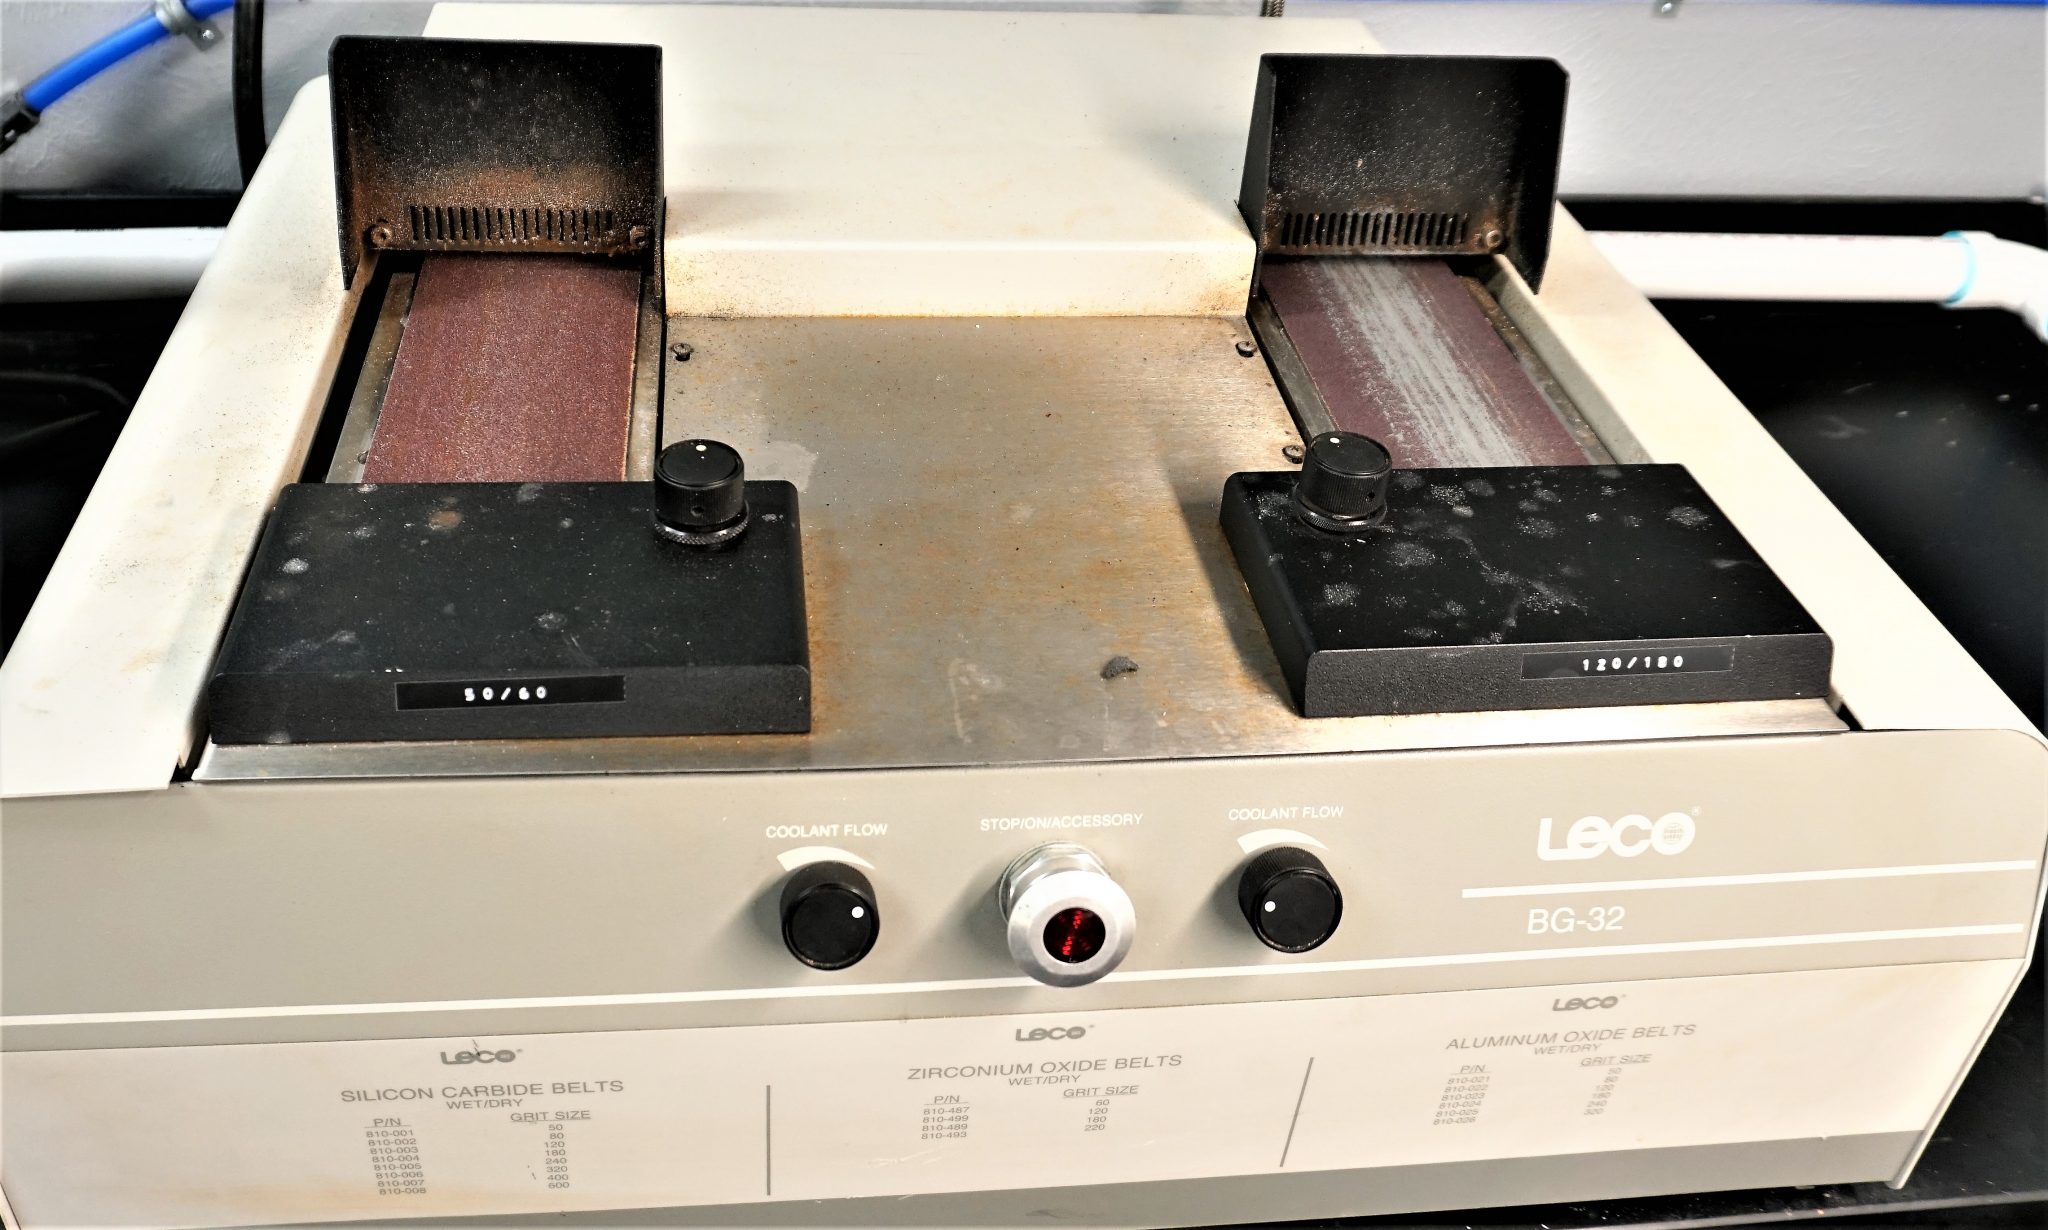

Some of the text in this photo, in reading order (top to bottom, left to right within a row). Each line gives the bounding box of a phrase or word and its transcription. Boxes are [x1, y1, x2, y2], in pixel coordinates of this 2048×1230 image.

[1583, 656, 1684, 671] 120/180
[464, 686, 547, 702] 50/60
[1228, 805, 1344, 822] COOLANT FLOW
[980, 813, 1144, 832] STOP/ON/ACCESSORY
[766, 822, 888, 838] COOLANT FLOW
[1527, 906, 1626, 934] BG-32
[1446, 1024, 1697, 1050] ALUMINUM OXIDE BELTS
[1533, 1043, 1602, 1056] WET/DRY
[1580, 1053, 1653, 1066] GRIT SIZE
[907, 1054, 1183, 1080] ZIRCONIUM OXIDE BELTS
[1459, 1064, 1486, 1074] P/N
[1008, 1074, 1081, 1087] WET/DRY
[341, 1080, 624, 1103] SILICON CARBIDE BELTS
[1063, 1085, 1139, 1097] GRIT SIZE
[447, 1098, 523, 1110] WET/DRY
[934, 1095, 960, 1104] P/N
[1095, 1098, 1110, 1106] 60
[923, 1106, 970, 1115] 810-487
[1089, 1107, 1109, 1115] 120
[510, 1110, 592, 1121] GRIT SIZE
[922, 1115, 969, 1123] 810-499
[1087, 1115, 1107, 1123] 180
[373, 1117, 401, 1126] P/N
[548, 1123, 563, 1131] 50
[921, 1123, 968, 1132] 810-489
[366, 1130, 413, 1138] 810-001
[549, 1132, 564, 1140] 80
[921, 1131, 967, 1140] 810-493
[368, 1138, 417, 1146] 810-002
[544, 1140, 565, 1148] 120
[370, 1146, 419, 1155] 810-003
[545, 1148, 566, 1156] 180
[372, 1155, 420, 1163] 810-004
[545, 1157, 567, 1165] 240
[373, 1163, 422, 1171] 810-005
[546, 1165, 568, 1173] 320
[375, 1171, 424, 1179] 810-006
[547, 1173, 569, 1181] 400
[377, 1179, 425, 1187] 810-007
[379, 1187, 427, 1195] 810-008
